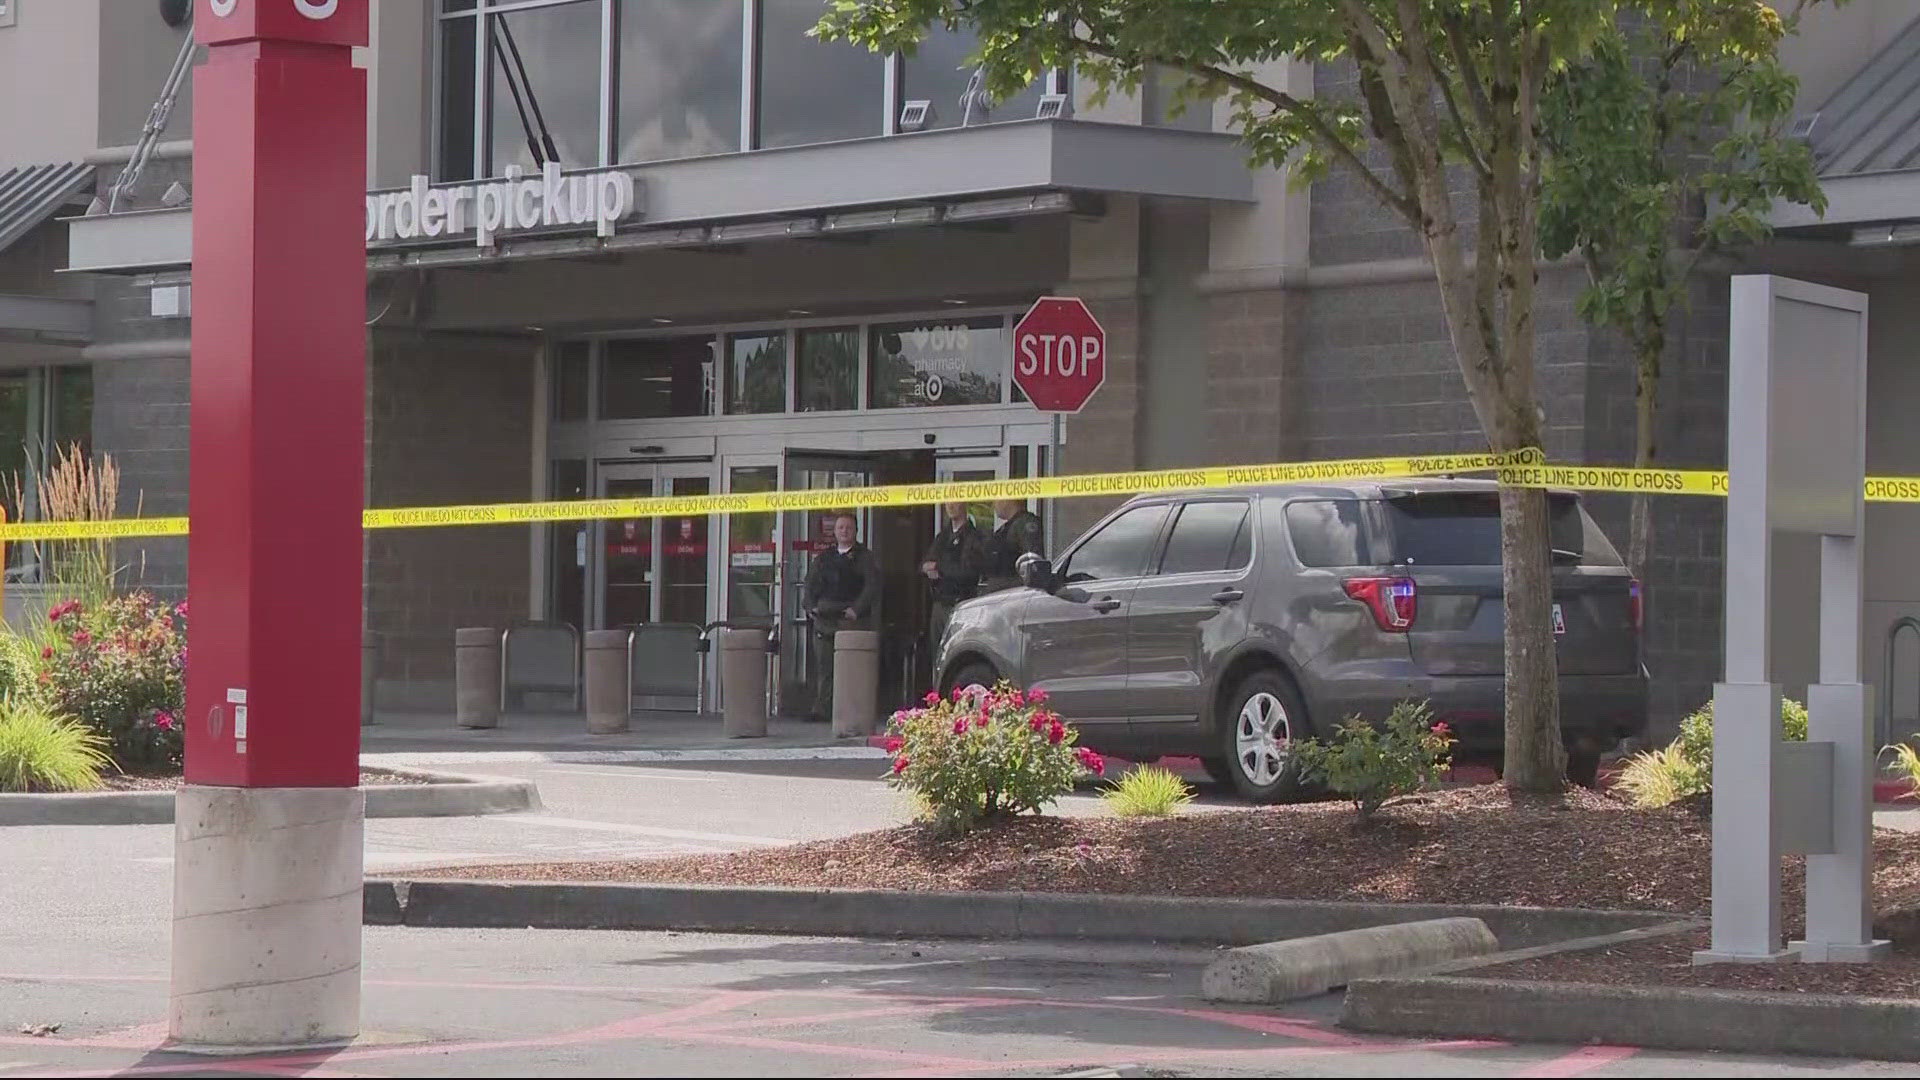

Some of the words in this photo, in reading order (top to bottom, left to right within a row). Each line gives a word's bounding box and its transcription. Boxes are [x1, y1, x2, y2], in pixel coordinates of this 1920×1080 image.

[476, 161, 634, 247] pickup
[1019, 333, 1101, 377] STOP
[914, 357, 967, 376] pharmacy
[914, 381, 927, 398] at
[1226, 468, 1268, 483] POLICE
[1270, 466, 1295, 481] LINE
[1297, 464, 1315, 479] DO
[1317, 463, 1342, 478] NOT
[1344, 461, 1386, 476] CROSS
[1408, 459, 1453, 472] POLICE
[1456, 458, 1483, 469] LINE
[1486, 456, 1504, 467] DO
[1060, 478, 1097, 493] POLICE
[1100, 476, 1122, 491] LINE
[1126, 474, 1141, 489] DO
[1144, 473, 1166, 488] NOT
[1167, 472, 1206, 486] CROSS
[1500, 468, 1541, 484] OLICE
[1544, 470, 1575, 485] LINE
[1578, 471, 1598, 487] DO
[1601, 472, 1630, 488] NOT
[1633, 472, 1684, 490] CROSS
[765, 494, 797, 507] POLICE
[799, 493, 818, 506] LINE
[820, 492, 834, 505] DO
[835, 491, 855, 504] NOT
[857, 489, 889, 503] CROSS
[907, 487, 941, 500] POLICE
[944, 485, 964, 498] LINE
[967, 484, 981, 497] DO
[983, 483, 1003, 496] NOT
[1006, 480, 1041, 495] CROSS
[1865, 481, 1919, 498] CROSS
